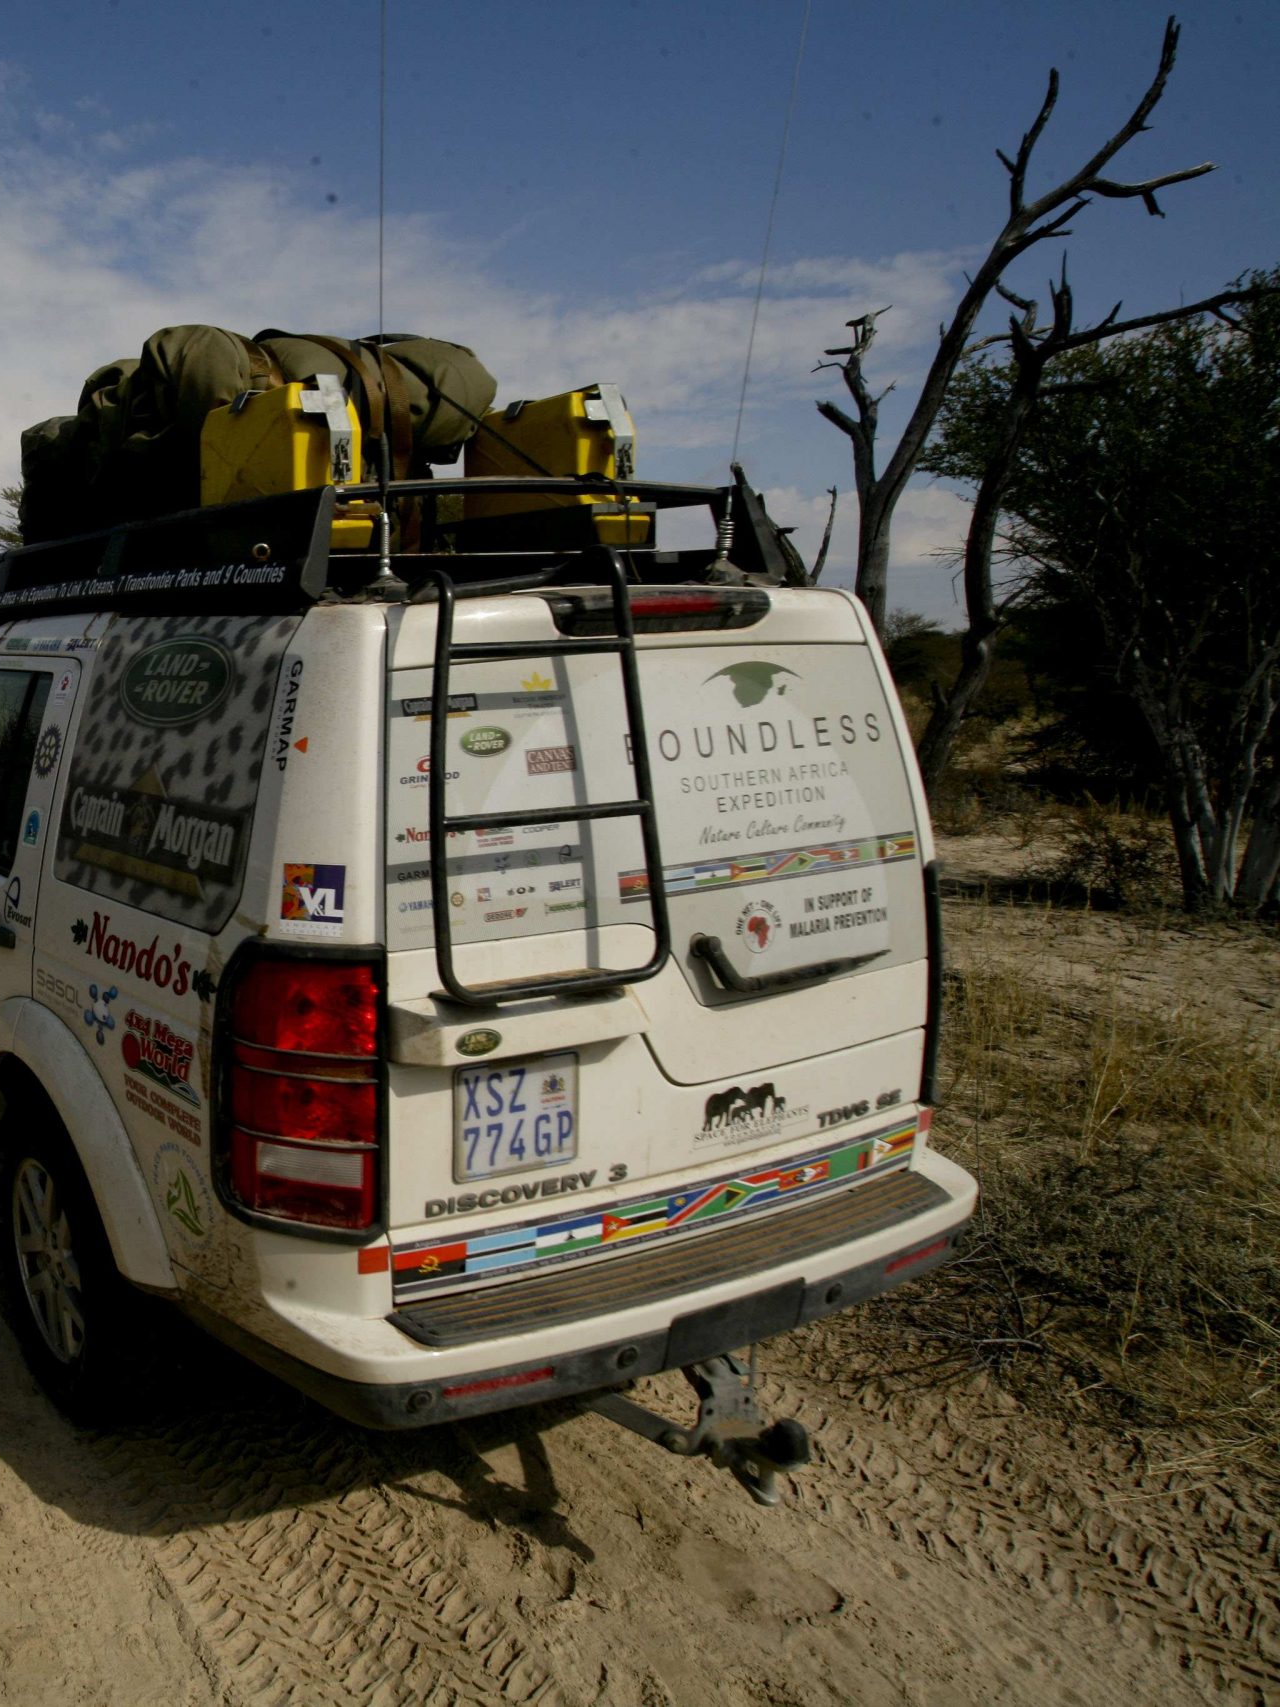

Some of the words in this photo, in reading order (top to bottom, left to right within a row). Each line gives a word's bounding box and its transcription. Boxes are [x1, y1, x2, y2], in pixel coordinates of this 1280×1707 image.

[124, 570, 177, 592] Transfrontier
[175, 567, 202, 588] Parks
[202, 565, 226, 586] and
[223, 564, 234, 584] 9
[233, 562, 286, 585] Countries
[144, 654, 200, 677] LAND
[141, 681, 210, 705] ROVER
[276, 659, 303, 772] GARMAP
[469, 731, 496, 742] LAND
[473, 740, 505, 751] ROVER
[527, 747, 574, 763] CANVAS
[400, 772, 460, 785] GRINOD
[680, 767, 783, 794] SOUTHERN
[788, 760, 850, 783] AFRICA
[716, 786, 826, 813] EXPEDITION
[70, 786, 125, 839] Captain
[145, 803, 234, 870] Morgan
[522, 823, 561, 834] COOPER
[699, 825, 741, 845] Nature
[746, 819, 789, 841] Culture
[804, 897, 815, 914] IN
[818, 890, 858, 912] SUPPORT
[861, 888, 873, 903] OF
[7, 905, 32, 928] Evosat
[790, 918, 831, 939] MALARIA
[834, 907, 888, 931] PREVENTION
[86, 911, 192, 996] Nando's
[153, 1019, 194, 1058] Mega
[140, 1036, 191, 1084] World
[463, 1067, 527, 1121] XSZ
[817, 1100, 870, 1129] TDV6
[876, 1088, 903, 1112] SE
[150, 1090, 202, 1131] COMPLETE
[167, 1116, 202, 1147] WORLD
[424, 1169, 598, 1219] DISCOVERY
[608, 1163, 629, 1184] 3
[414, 1238, 441, 1251] Angola
